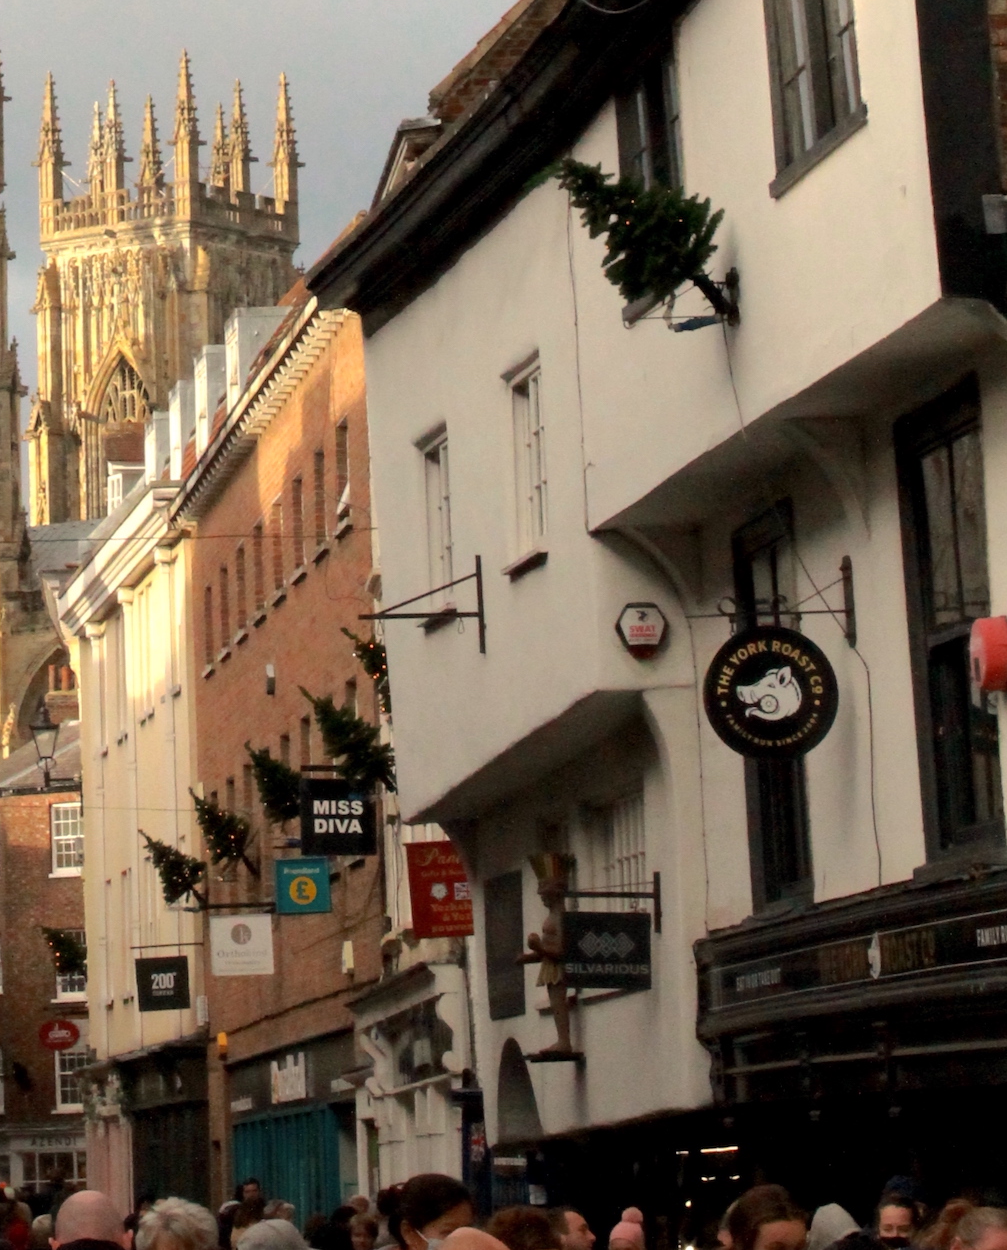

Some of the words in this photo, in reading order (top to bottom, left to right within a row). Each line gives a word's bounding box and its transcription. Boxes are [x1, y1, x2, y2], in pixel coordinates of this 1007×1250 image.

[629, 625, 656, 633] SWAT
[717, 665, 735, 695] THE
[729, 640, 768, 665] YORK
[772, 640, 817, 672] ROAST
[313, 800, 363, 815] MISS
[314, 818, 363, 834] DIVA
[566, 963, 649, 975] SILVARIOUS
[31, 1137, 77, 1147] AZENDI
